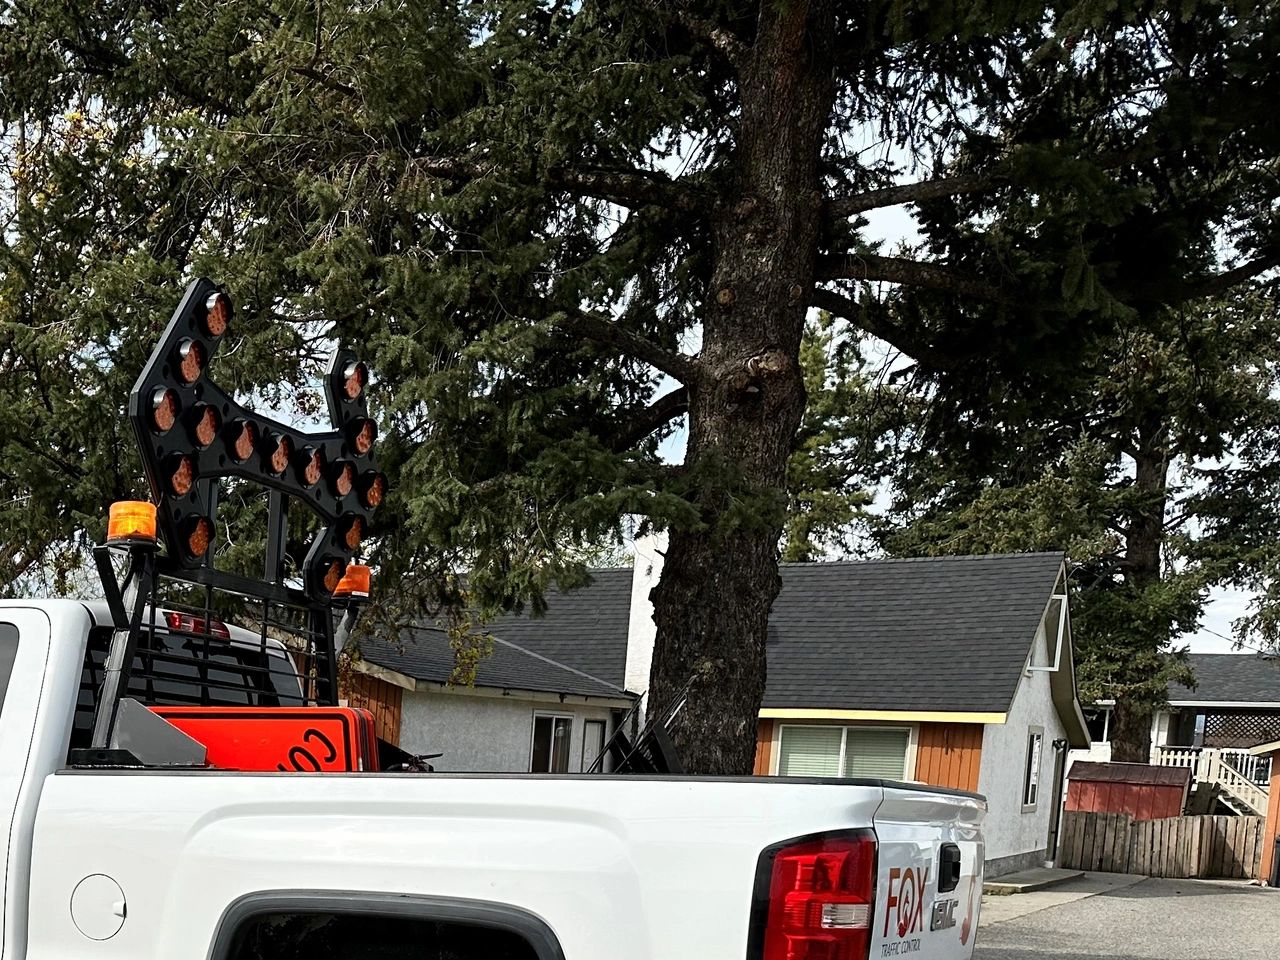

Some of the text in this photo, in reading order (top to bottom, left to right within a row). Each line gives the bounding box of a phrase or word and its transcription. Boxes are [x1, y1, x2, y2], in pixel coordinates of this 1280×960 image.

[277, 728, 337, 771] CO
[883, 867, 929, 938] FOX
[881, 938, 921, 959] TRAFFIC CONTROL
